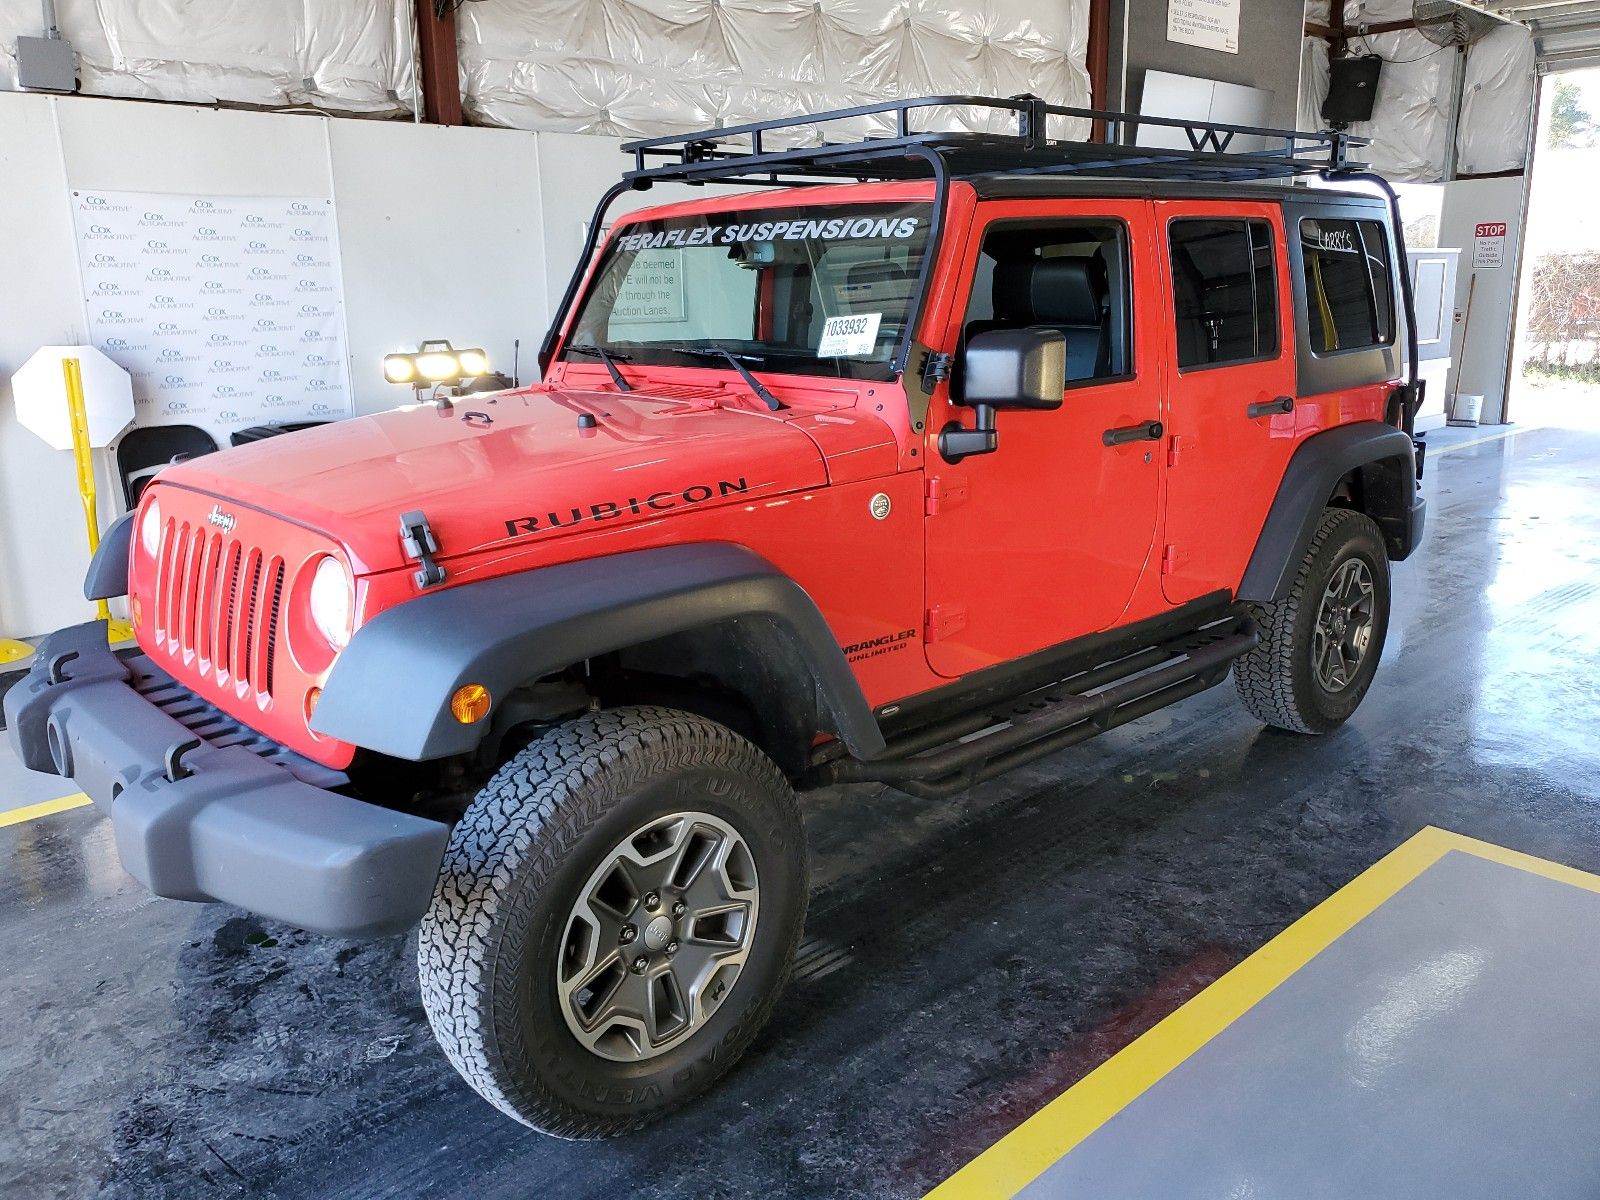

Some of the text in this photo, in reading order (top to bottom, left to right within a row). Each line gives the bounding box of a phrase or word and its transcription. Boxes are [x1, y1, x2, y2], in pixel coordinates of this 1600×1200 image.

[616, 227, 721, 252] TERAFLEX
[721, 218, 919, 243] SUSPENSIONS
[1476, 225, 1505, 236] STOP
[643, 259, 675, 269] deemed
[636, 275, 648, 284] will
[650, 275, 662, 284] not
[664, 274, 674, 284] be
[625, 291, 656, 302] through
[657, 291, 670, 299] the
[644, 306, 670, 315] Lanes.
[827, 318, 867, 336] 1033932
[505, 478, 748, 536] RUBICON
[849, 643, 907, 662] UNLIMITED
